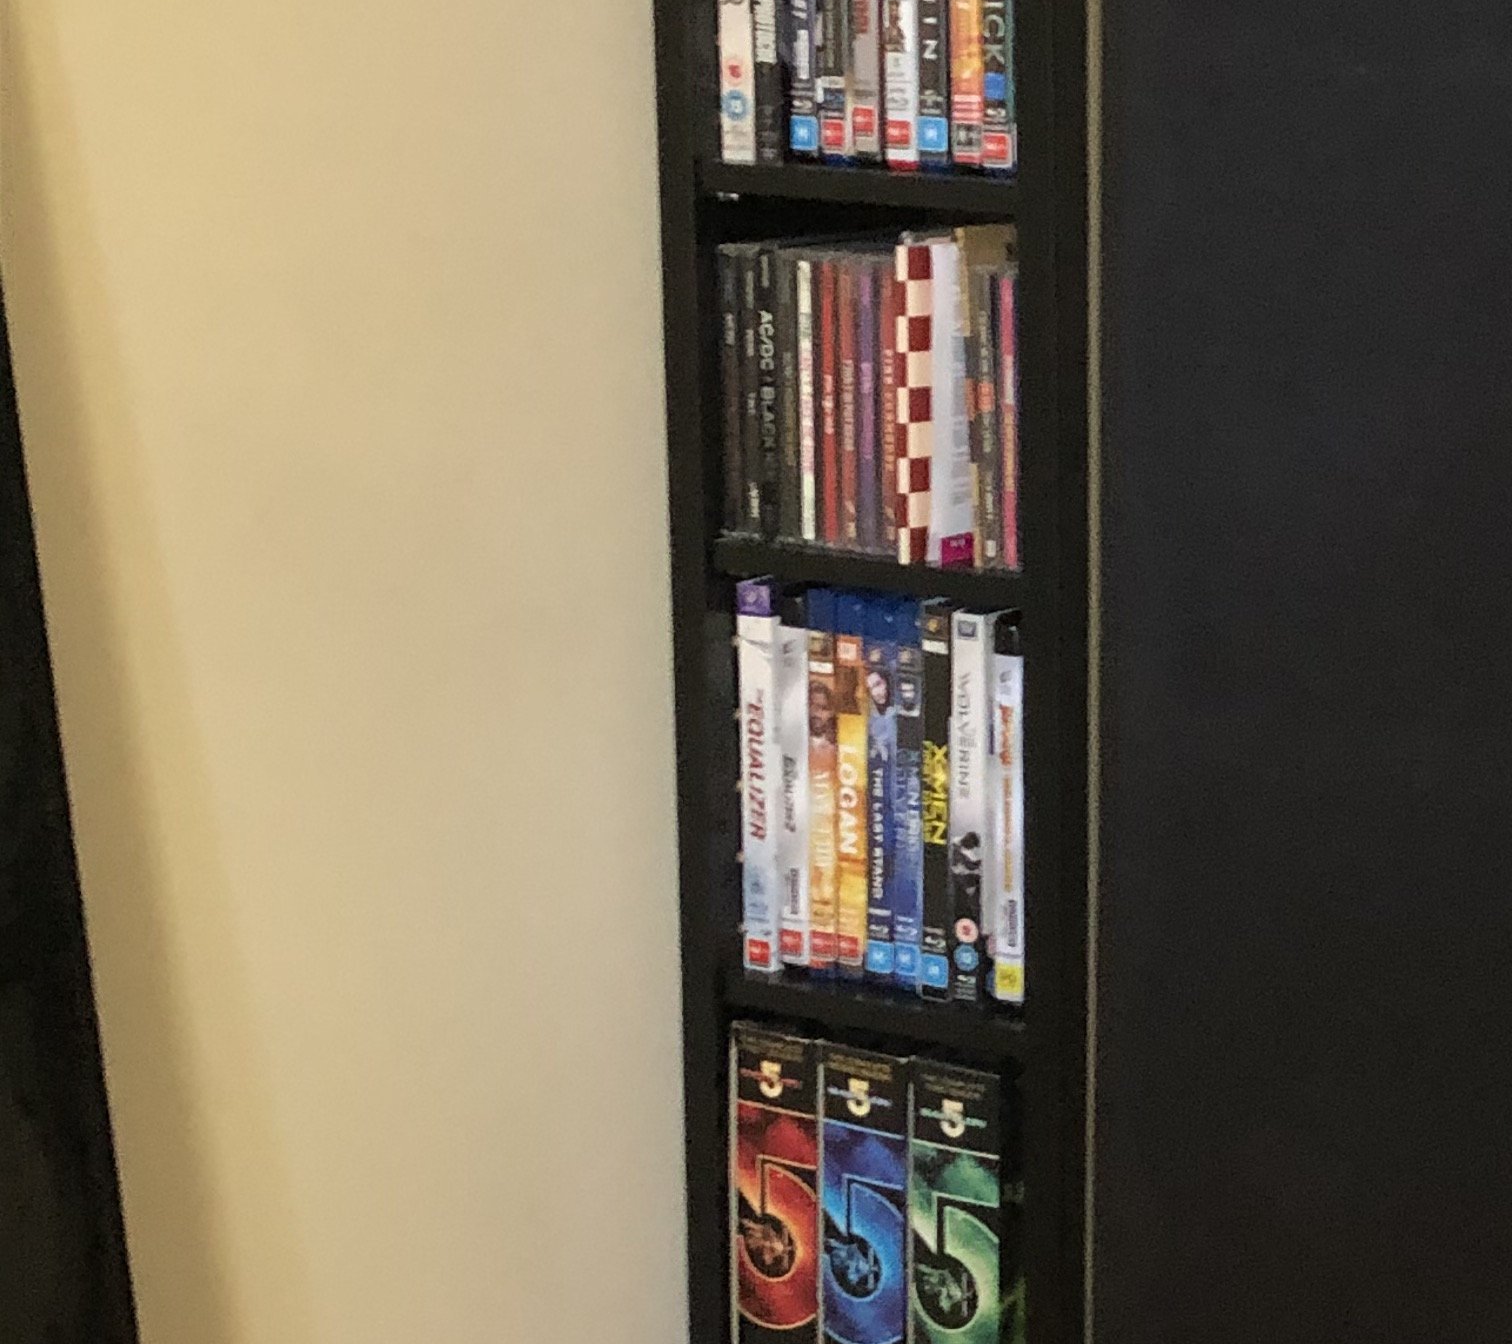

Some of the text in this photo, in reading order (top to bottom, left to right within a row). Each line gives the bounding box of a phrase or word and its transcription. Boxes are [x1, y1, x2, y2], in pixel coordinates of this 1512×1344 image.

[759, 310, 776, 448] AC/DC BLACK
[746, 702, 768, 841] EQUALIZER
[956, 672, 973, 801] WOLVERINE
[840, 742, 858, 855] LOGAN
[872, 802, 884, 842] LAST
[931, 745, 949, 845] X-MEN
[759, 1061, 784, 1098] 5
[847, 1078, 871, 1117] 5
[940, 1098, 966, 1137] 5
